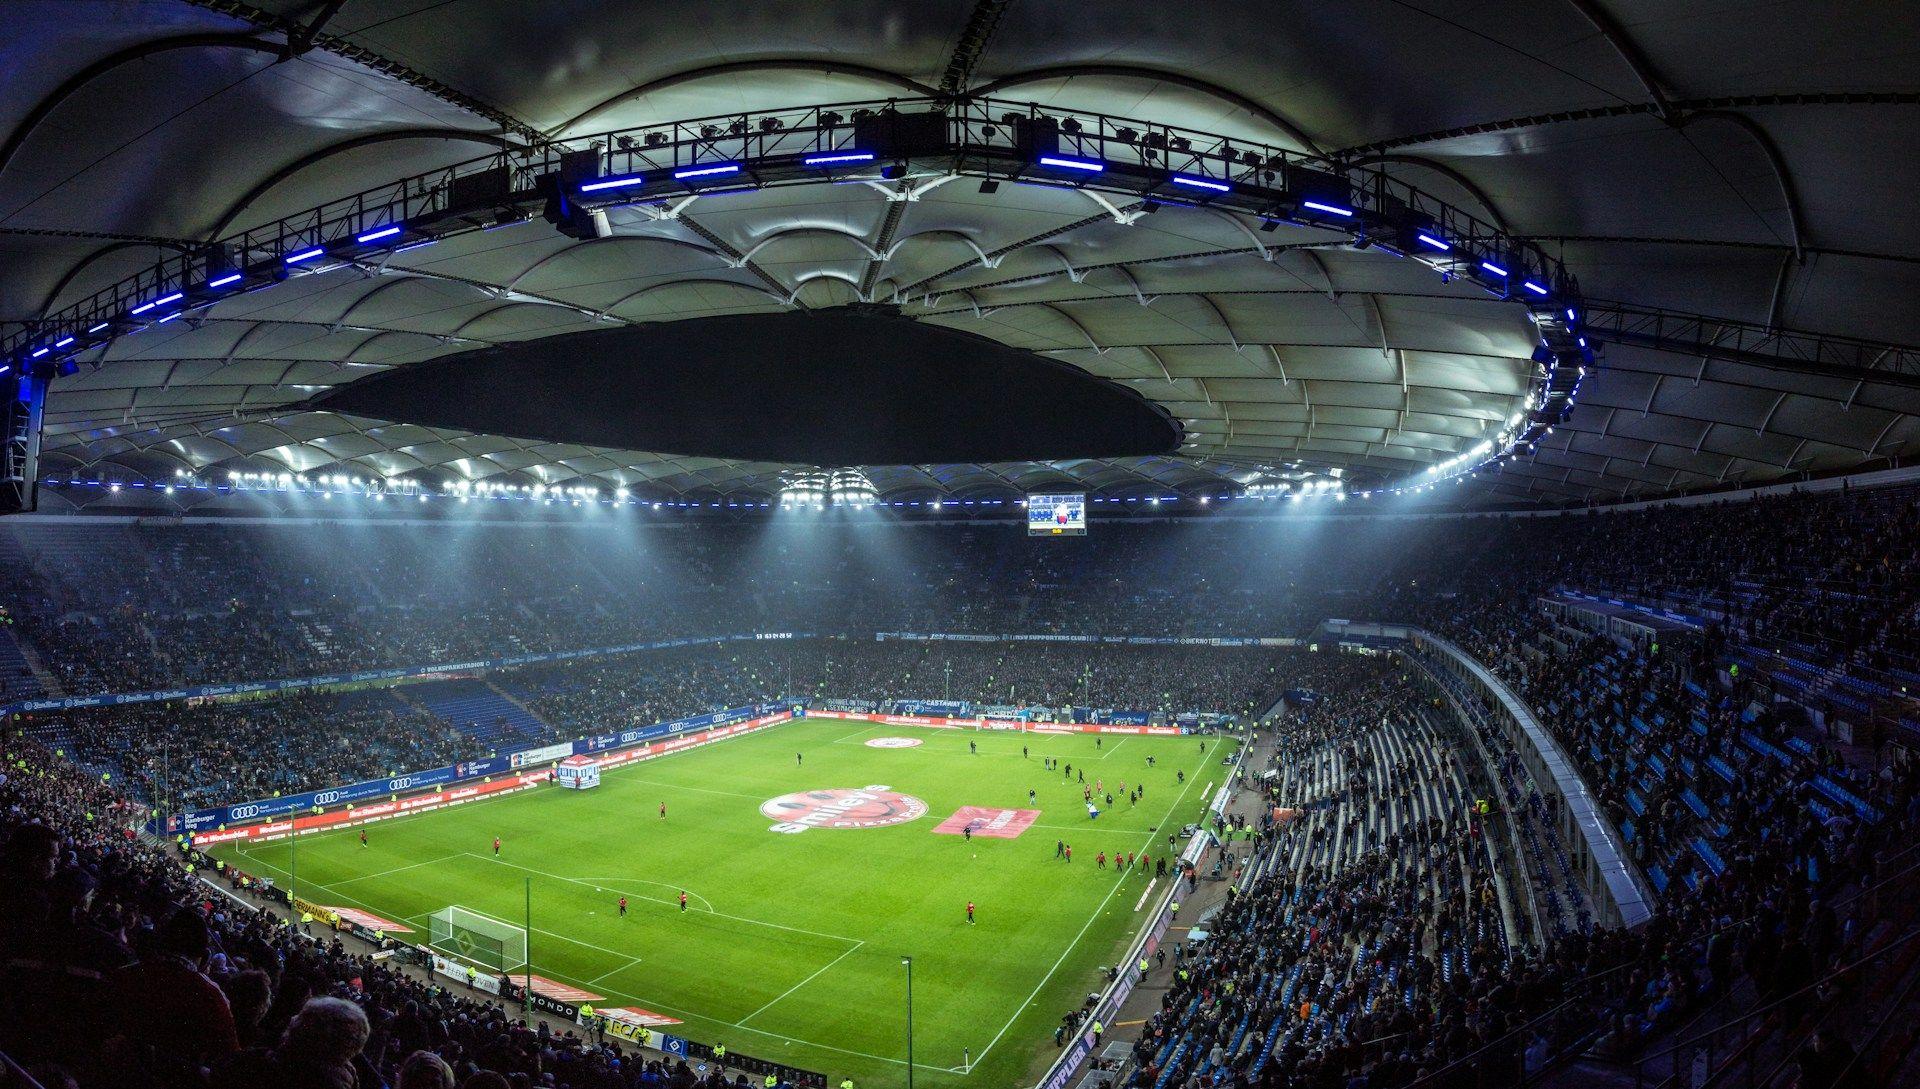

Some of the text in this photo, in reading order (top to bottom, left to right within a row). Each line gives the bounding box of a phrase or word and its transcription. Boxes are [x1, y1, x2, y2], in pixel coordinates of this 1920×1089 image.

[426, 661, 484, 672] VOLKSPARKSTADION
[184, 815, 215, 824] Hamburger
[833, 817, 902, 828] Pizza
[209, 830, 250, 842] Wochenblatt
